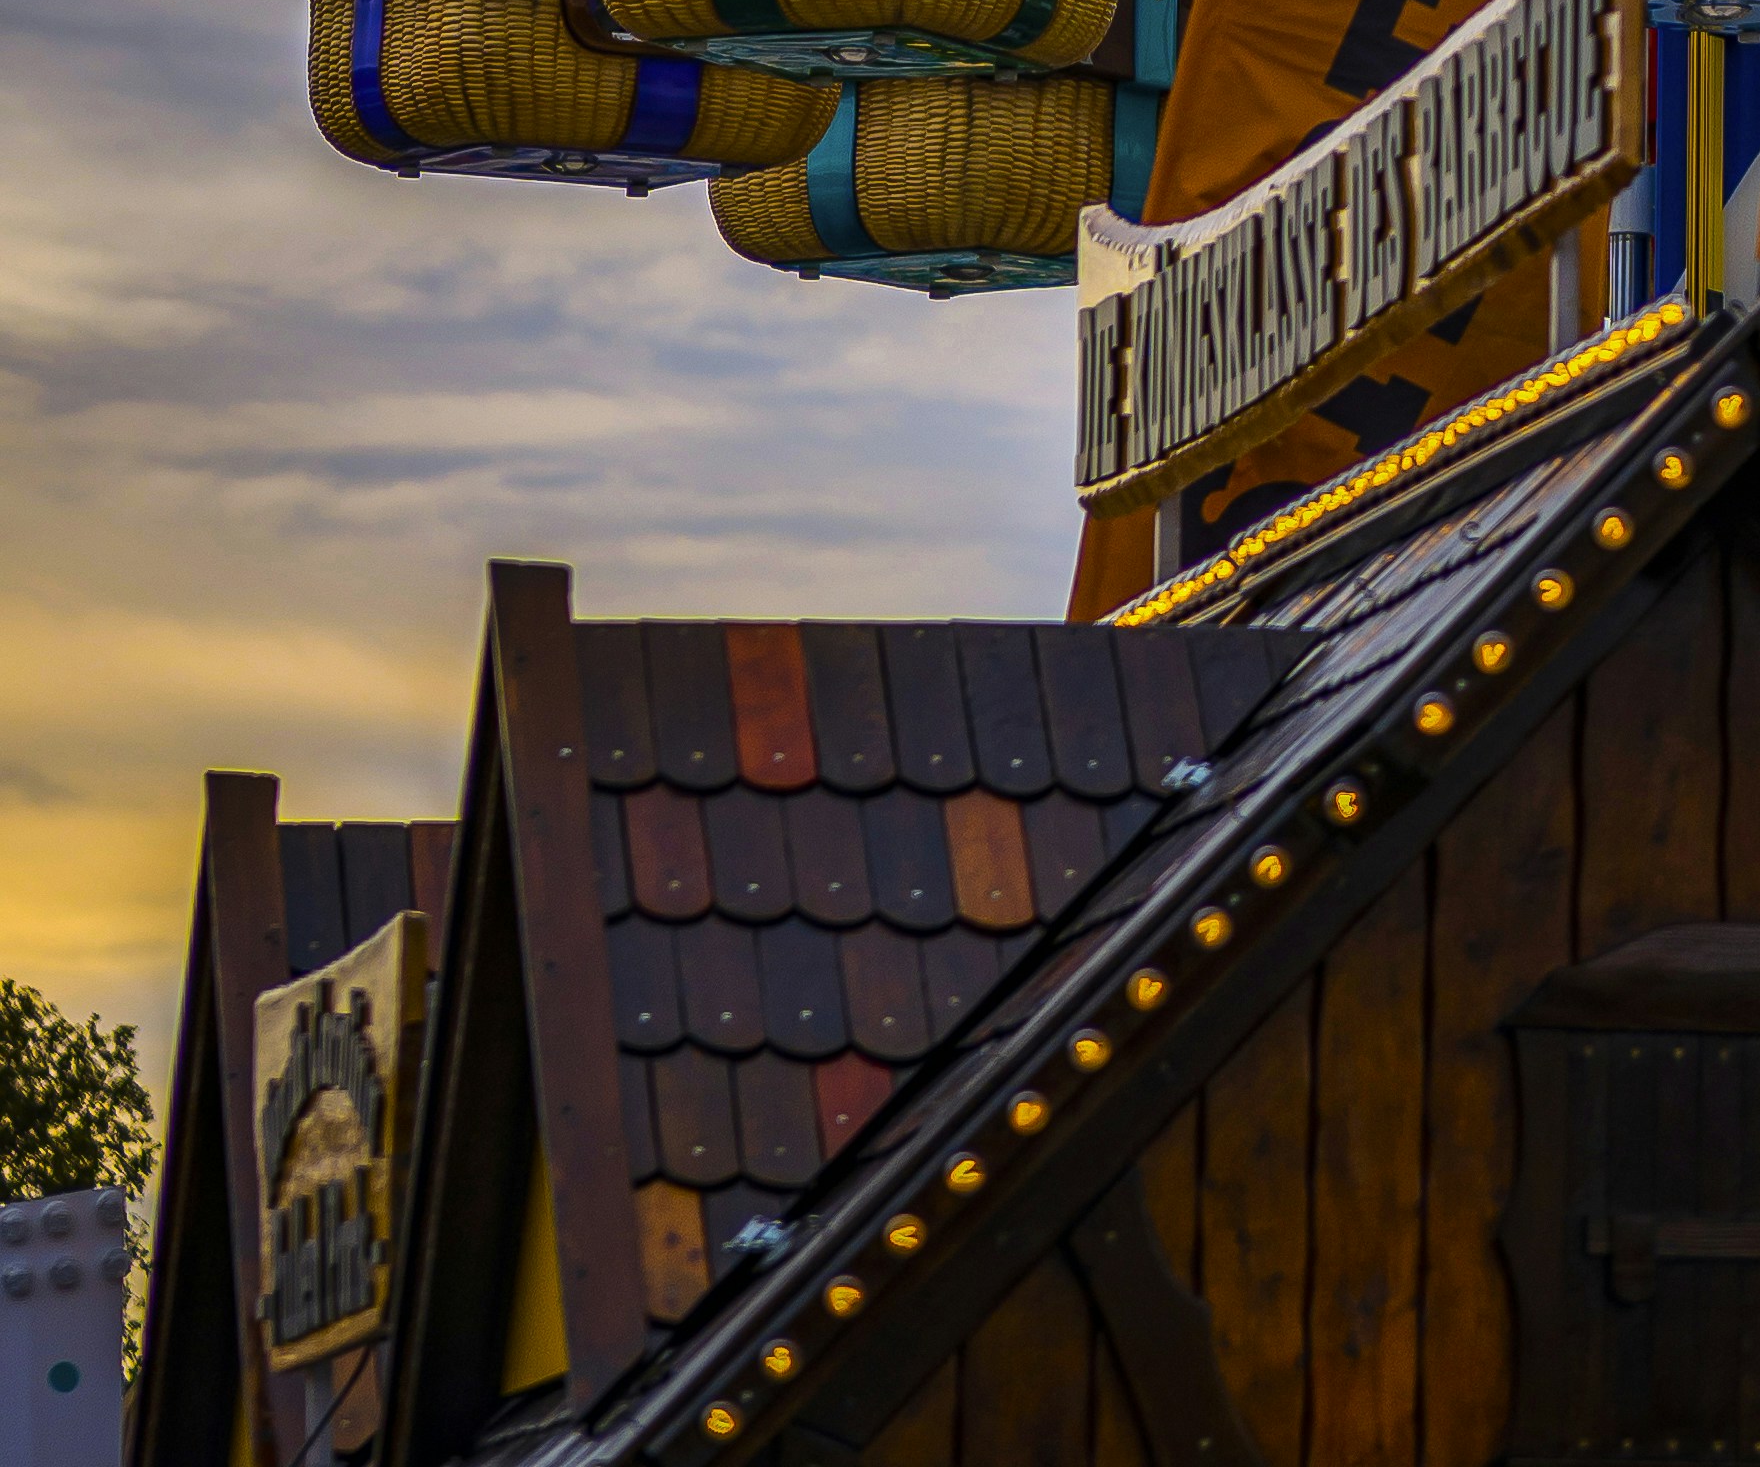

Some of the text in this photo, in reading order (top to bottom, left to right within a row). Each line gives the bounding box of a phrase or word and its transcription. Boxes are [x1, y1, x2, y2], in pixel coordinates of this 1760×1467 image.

[1075, 292, 1121, 486] DIE
[1127, 157, 1338, 469] KÖNIGSKLASSE
[1344, 96, 1408, 334] DES
